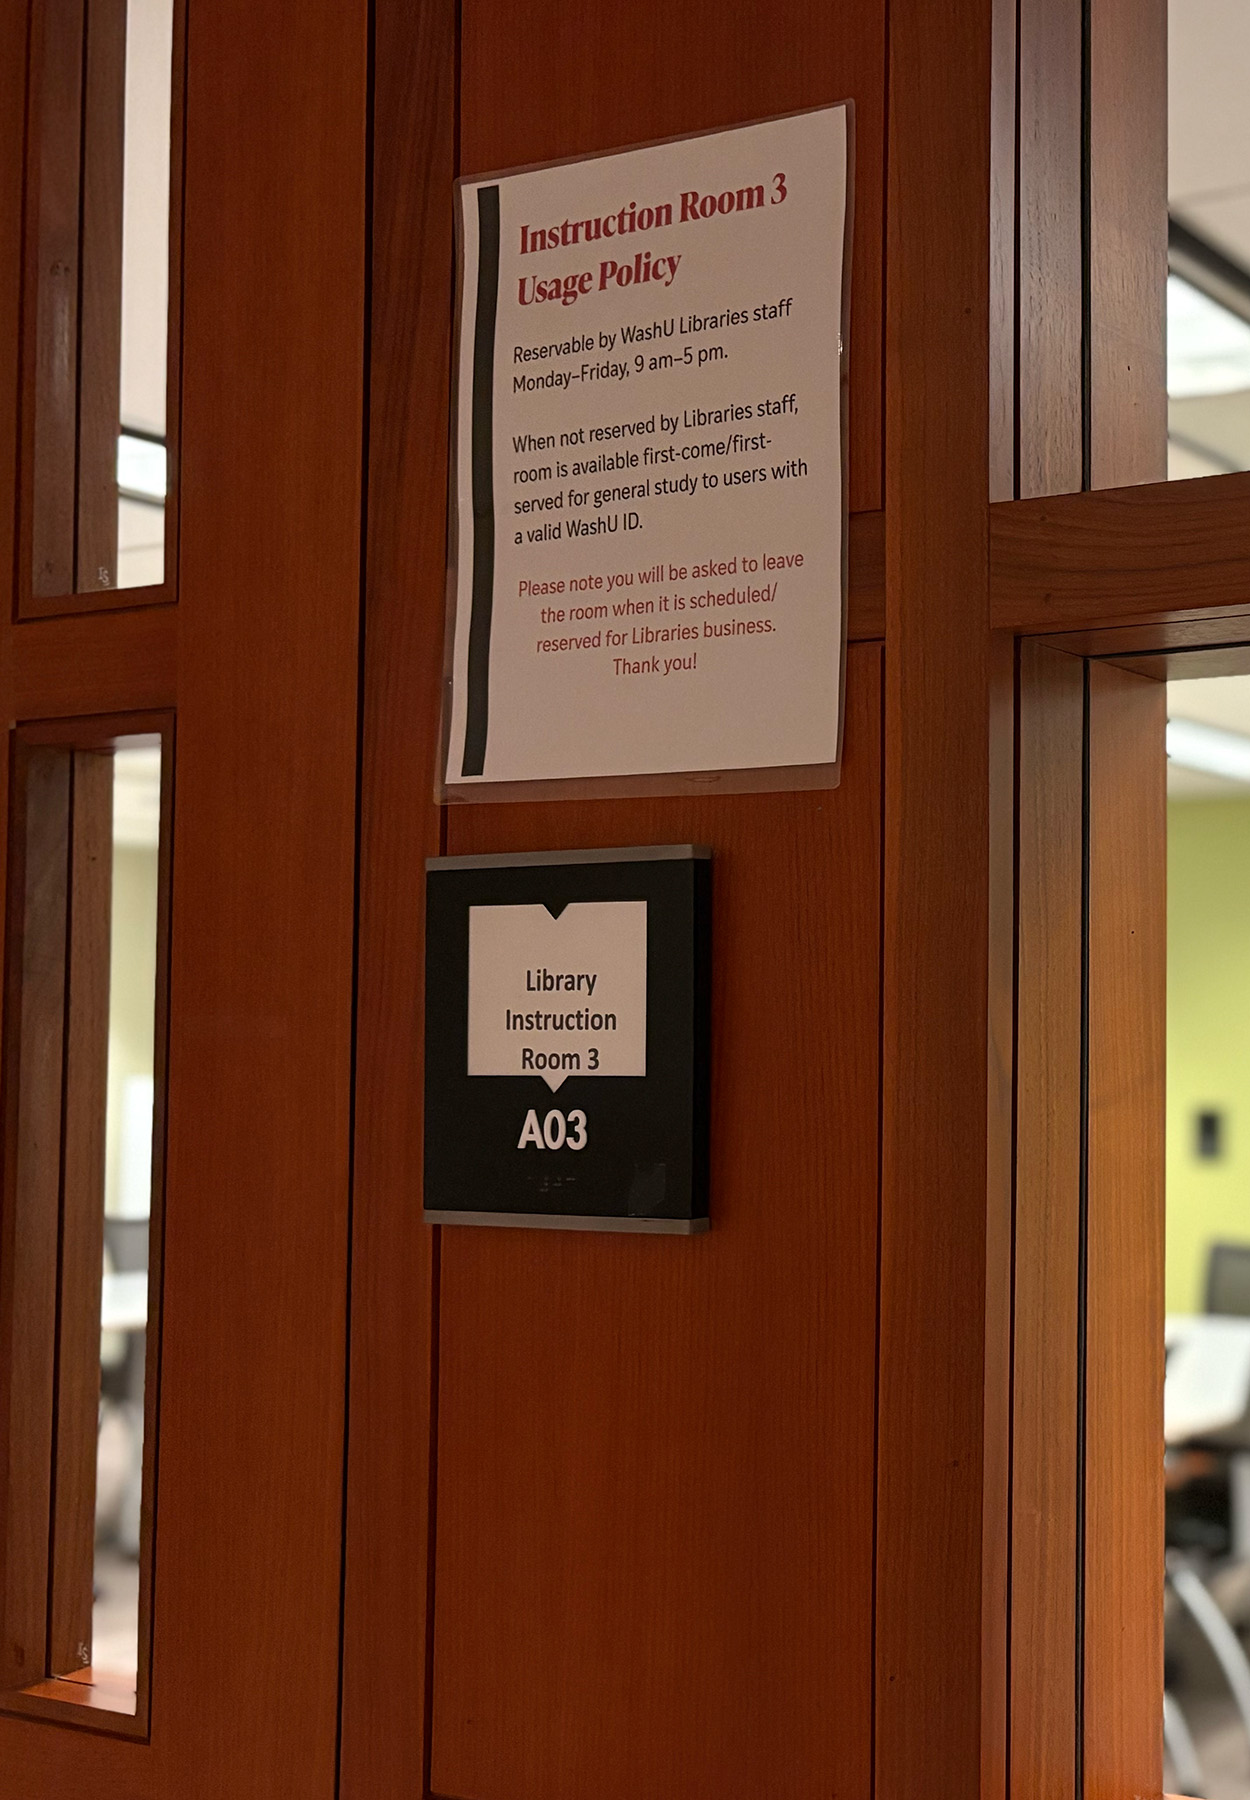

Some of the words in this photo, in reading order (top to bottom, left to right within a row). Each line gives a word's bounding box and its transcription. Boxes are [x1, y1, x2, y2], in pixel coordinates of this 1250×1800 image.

[520, 204, 672, 255] Instruction
[679, 185, 765, 223] Room
[771, 173, 787, 204] 3
[519, 272, 593, 306] Usage
[598, 251, 682, 291] Policy
[514, 335, 594, 364] Reservable
[599, 332, 616, 351] by
[621, 319, 674, 344] WashU
[680, 309, 748, 334] Libraries
[753, 298, 793, 321] staff
[635, 355, 644, 373] 9
[698, 346, 728, 367] pm.
[512, 435, 555, 453] When
[560, 428, 585, 447] not
[590, 415, 655, 442] reserved
[661, 414, 679, 435] by
[684, 405, 752, 428] Libraries
[757, 393, 798, 417] staff,
[514, 467, 552, 484] room
[556, 463, 568, 478] is
[572, 450, 639, 476] available
[643, 434, 771, 465] first-come/first-
[514, 491, 563, 514] served
[568, 489, 589, 508] for
[593, 479, 649, 508] general
[655, 475, 698, 495] study
[701, 473, 718, 490] to
[724, 468, 766, 486] users
[771, 458, 807, 479] with
[514, 532, 522, 544] a
[527, 522, 561, 542] valid
[566, 515, 617, 537] WashU
[624, 512, 642, 530] ID.
[519, 580, 565, 597] Please
[570, 575, 603, 591] note
[607, 573, 633, 592] you
[638, 565, 663, 584] will
[669, 564, 687, 581] be
[692, 557, 737, 578] asked
[742, 557, 758, 573] to
[763, 553, 804, 570] leave
[541, 607, 565, 623] the
[570, 606, 607, 621] room
[613, 599, 654, 616] when
[659, 596, 669, 612] it
[674, 598, 685, 610] is
[690, 582, 777, 609] scheduled/
[537, 631, 601, 652] reserved
[606, 630, 628, 646] for
[632, 626, 699, 644] Libraries
[704, 620, 776, 637] business.
[613, 656, 659, 675] Thank
[663, 652, 696, 676] you!
[527, 969, 596, 995] Library
[507, 1008, 616, 1030] Instruction
[523, 1048, 580, 1069] Room
[588, 1048, 599, 1070] 3
[518, 1110, 587, 1150] A03
